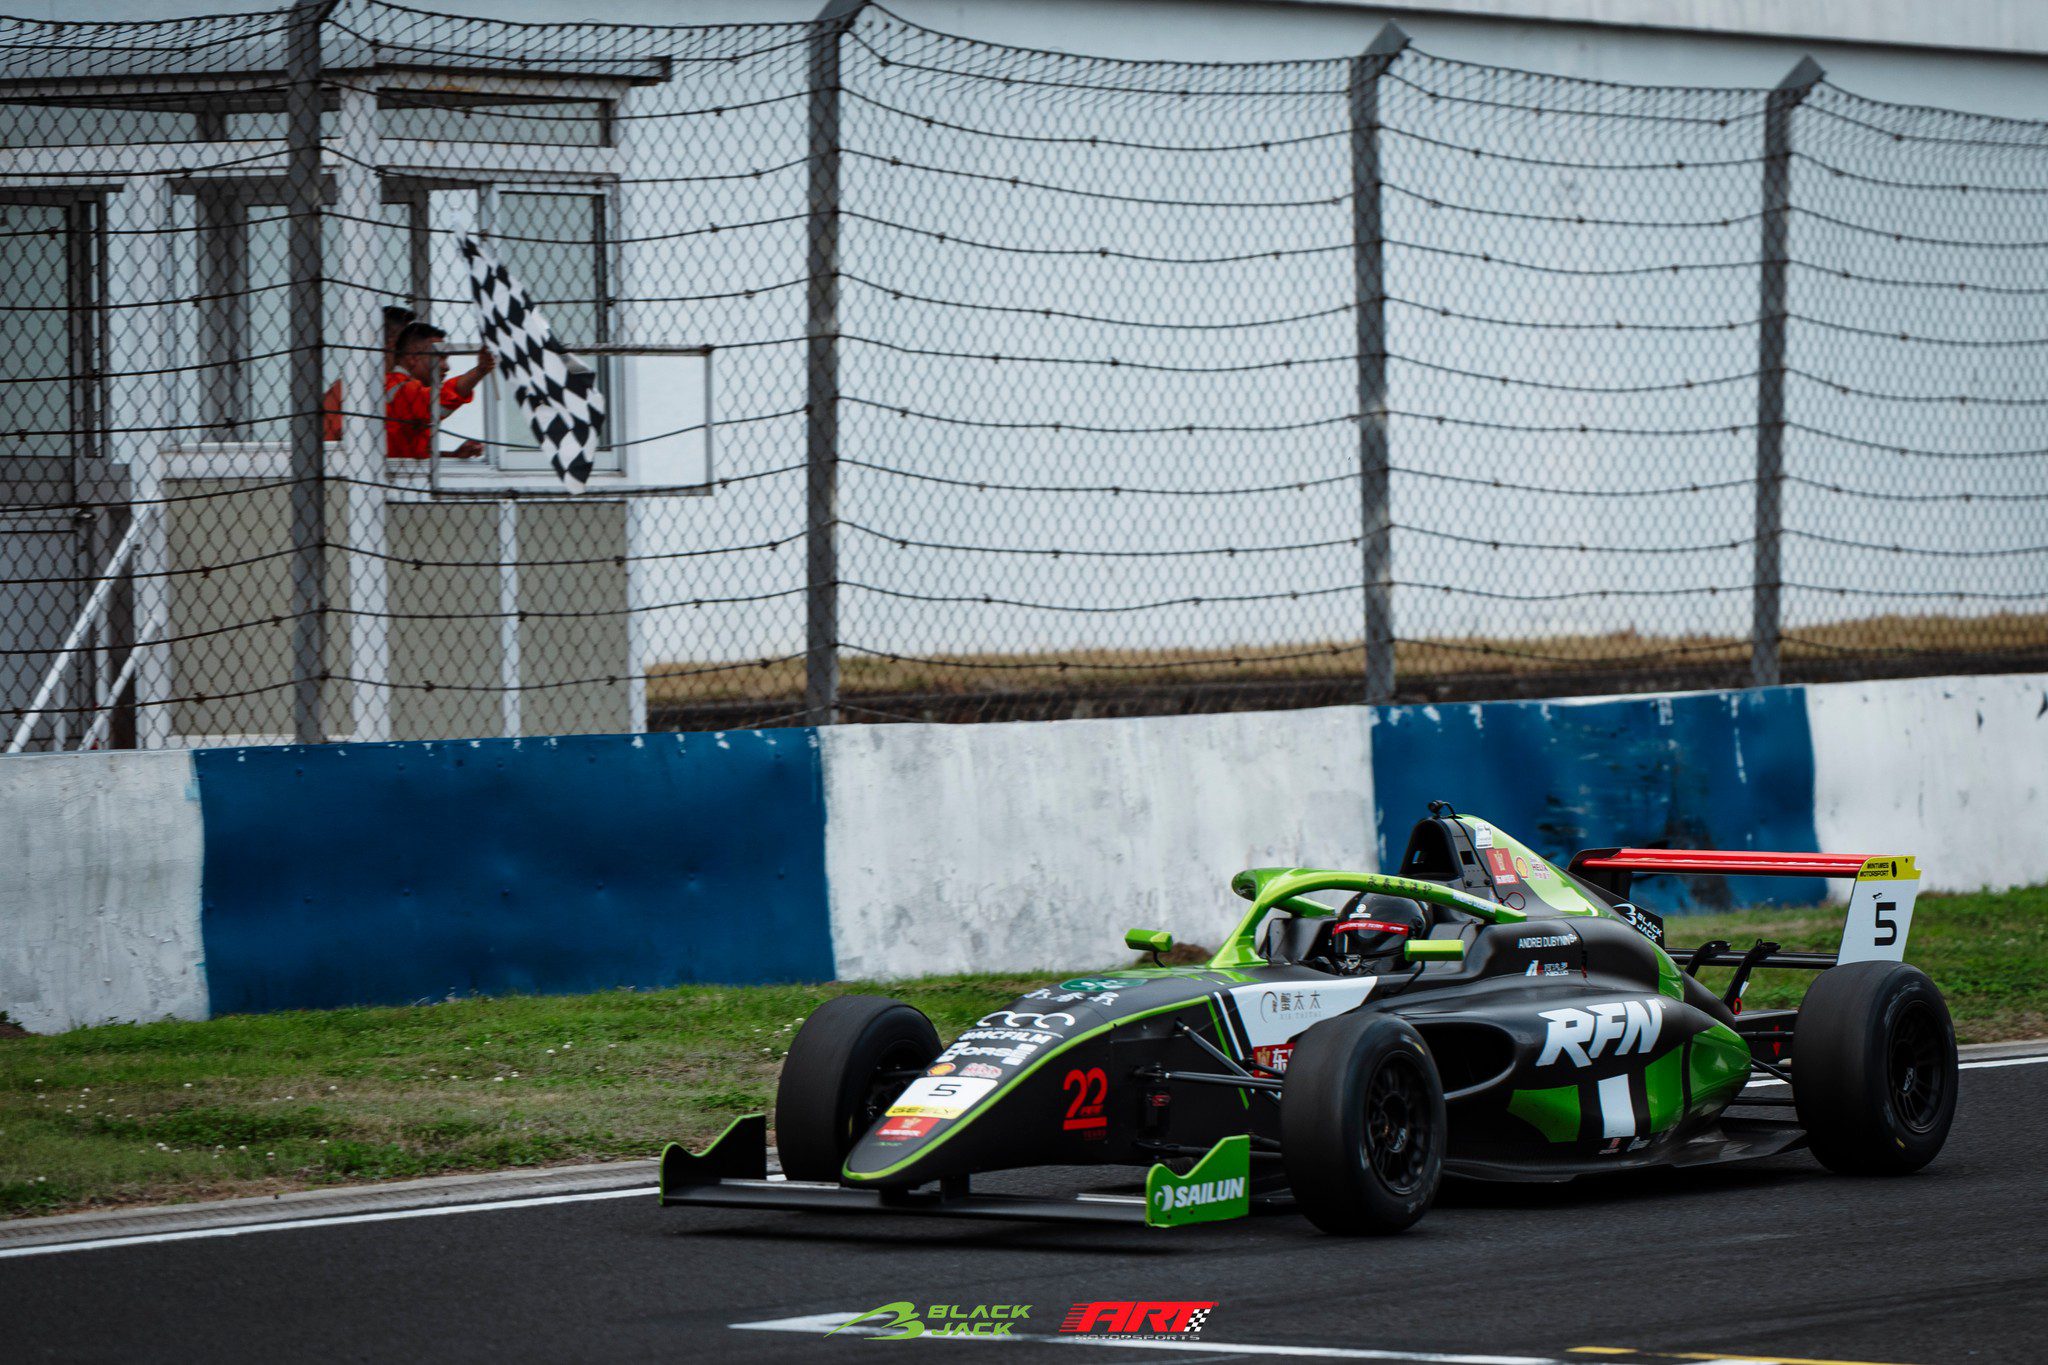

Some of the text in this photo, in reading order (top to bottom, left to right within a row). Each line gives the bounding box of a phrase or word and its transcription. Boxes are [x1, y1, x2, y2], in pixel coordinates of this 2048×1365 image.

[1636, 912, 1662, 937] BLACK
[1636, 924, 1658, 942] JACK
[1874, 902, 1897, 946] 5
[1518, 936, 1542, 948] ANDREI
[1535, 999, 1663, 1068] RFN
[1272, 1048, 1294, 1072] 东
[928, 1084, 962, 1097] 5
[1063, 1067, 1108, 1130] 22
[1174, 1177, 1245, 1208] SAILUN
